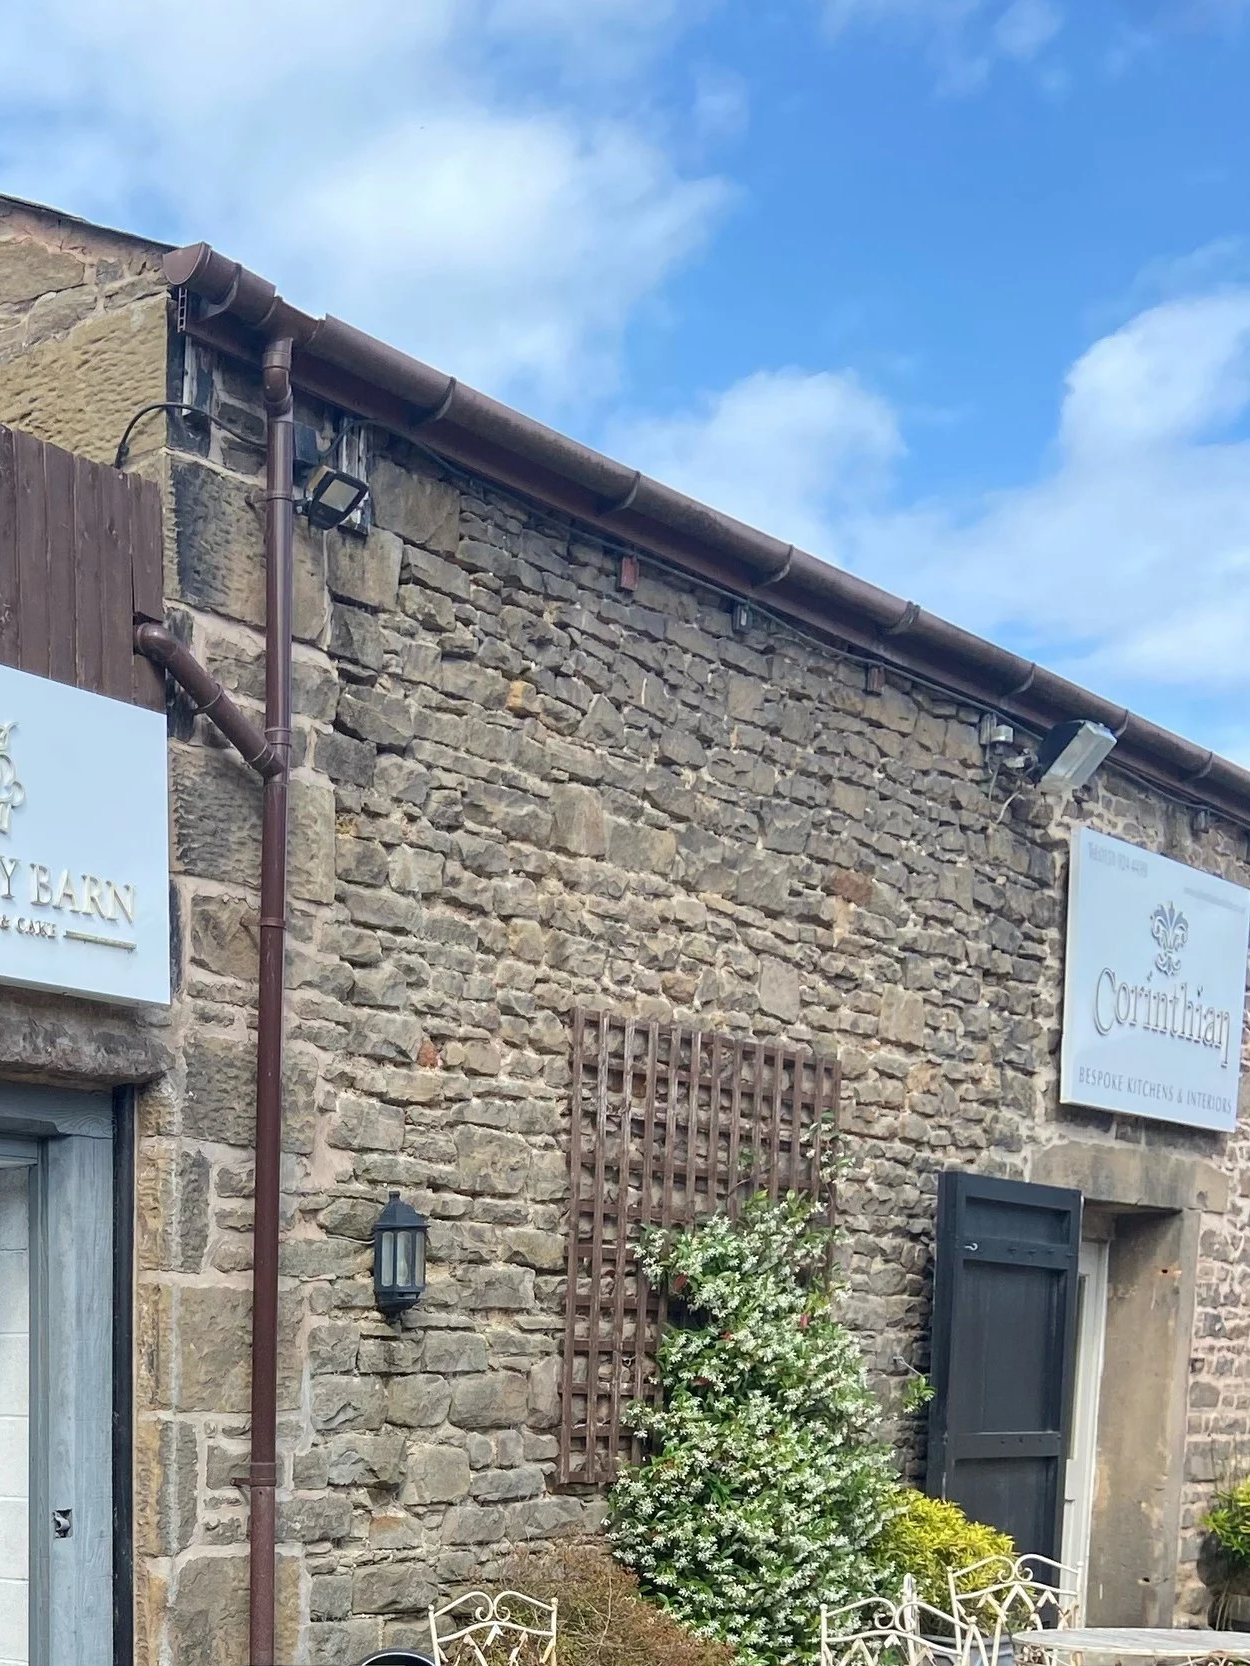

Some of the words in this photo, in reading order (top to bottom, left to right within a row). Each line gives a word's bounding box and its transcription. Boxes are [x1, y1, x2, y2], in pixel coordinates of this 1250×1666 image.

[30, 862, 136, 926] BARN
[0, 915, 11, 930] &
[16, 916, 58, 938] CAKE
[1093, 966, 1231, 1068] Corinthian
[1079, 1065, 1124, 1092] BESPOKE
[1126, 1076, 1174, 1103] KITCHENS
[1176, 1087, 1183, 1105] &
[1186, 1089, 1232, 1114] INTERIORS
